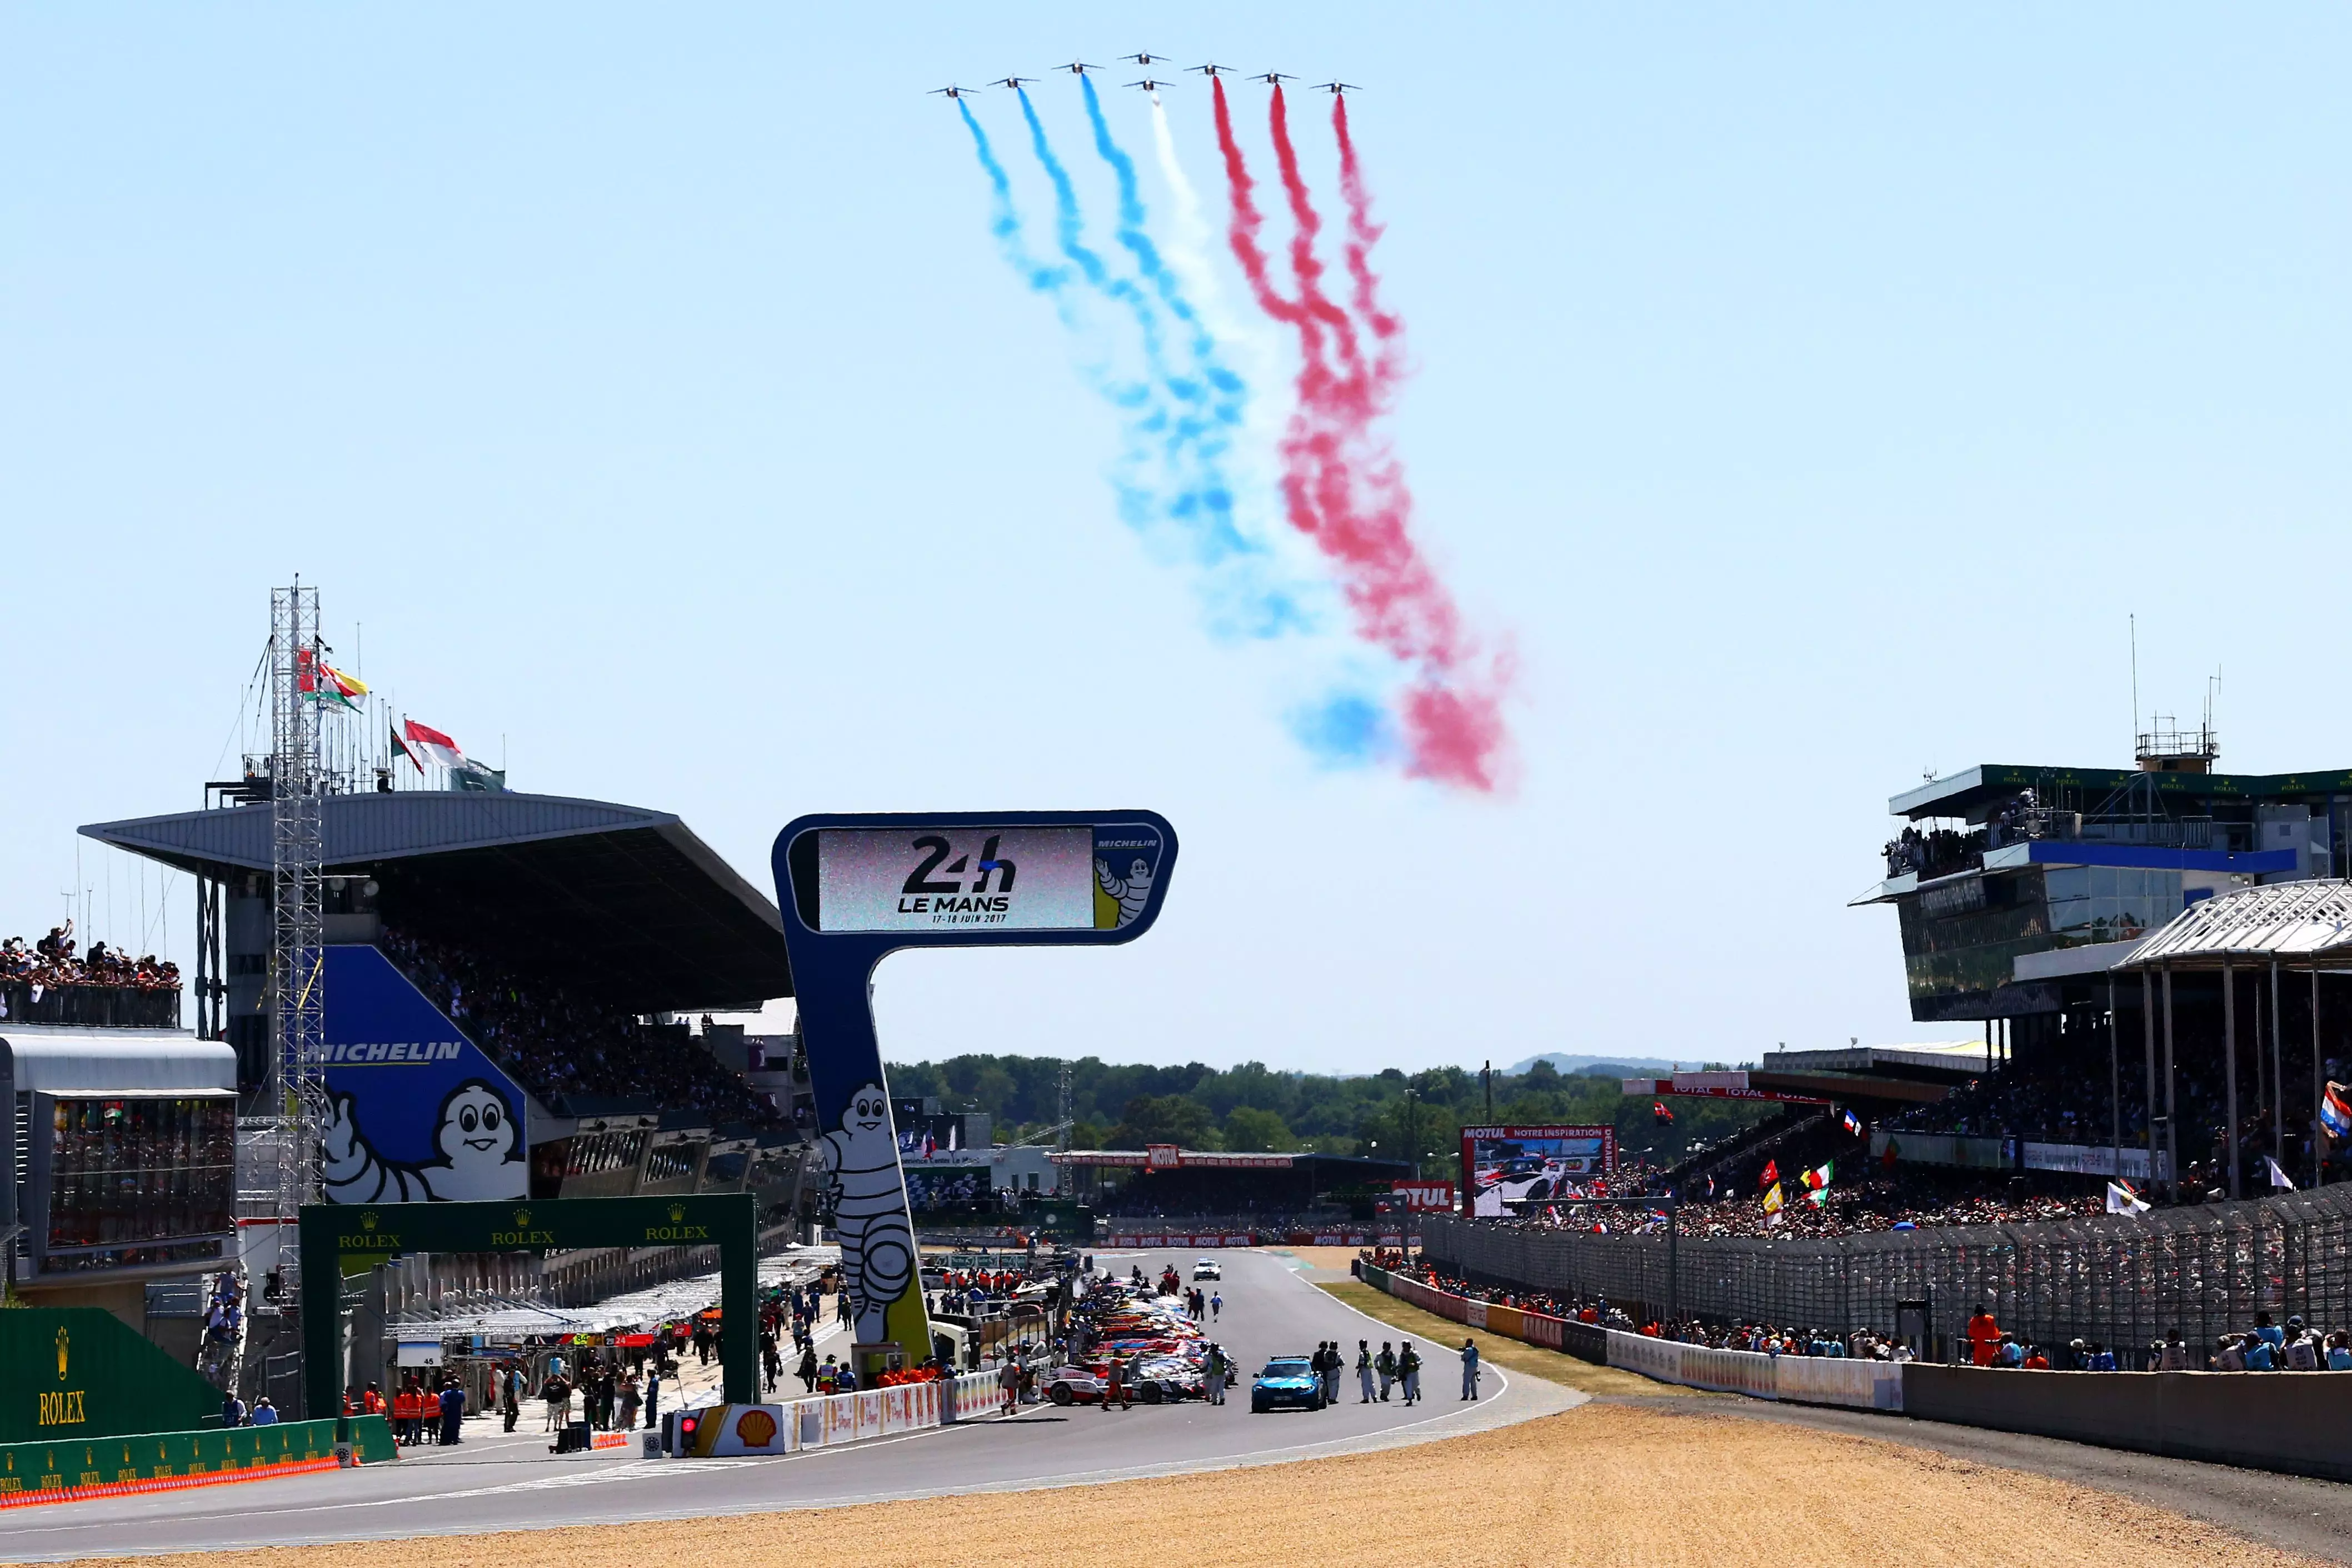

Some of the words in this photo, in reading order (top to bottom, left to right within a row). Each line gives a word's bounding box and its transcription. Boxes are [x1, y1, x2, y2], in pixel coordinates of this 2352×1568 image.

[901, 835, 1016, 894] 24h
[897, 897, 930, 913] LE
[934, 897, 1009, 913] MANS
[984, 914, 1006, 922] 2017
[1725, 1087, 1765, 1097] TOTAL
[1464, 1128, 1506, 1138] MOTUL
[1545, 1128, 1602, 1137] INSPIRATION
[1150, 1148, 1177, 1165] MOTUL
[491, 1231, 555, 1245] ROLEX
[645, 1226, 709, 1240] ROLEX
[1314, 1235, 1341, 1245] MOTUL
[338, 1235, 402, 1247] ROLEX
[1141, 1236, 1162, 1246] MOTUL
[1166, 1237, 1190, 1246] MOTUL
[1194, 1236, 1220, 1246] MOTUL
[1224, 1236, 1250, 1246] MOTUL
[39, 1391, 86, 1425] ROLEX
[41, 1474, 62, 1488] ROLEX
[81, 1471, 100, 1485] ROLEX
[118, 1468, 137, 1482] ROLEX
[0, 1477, 22, 1492] ROLEX
